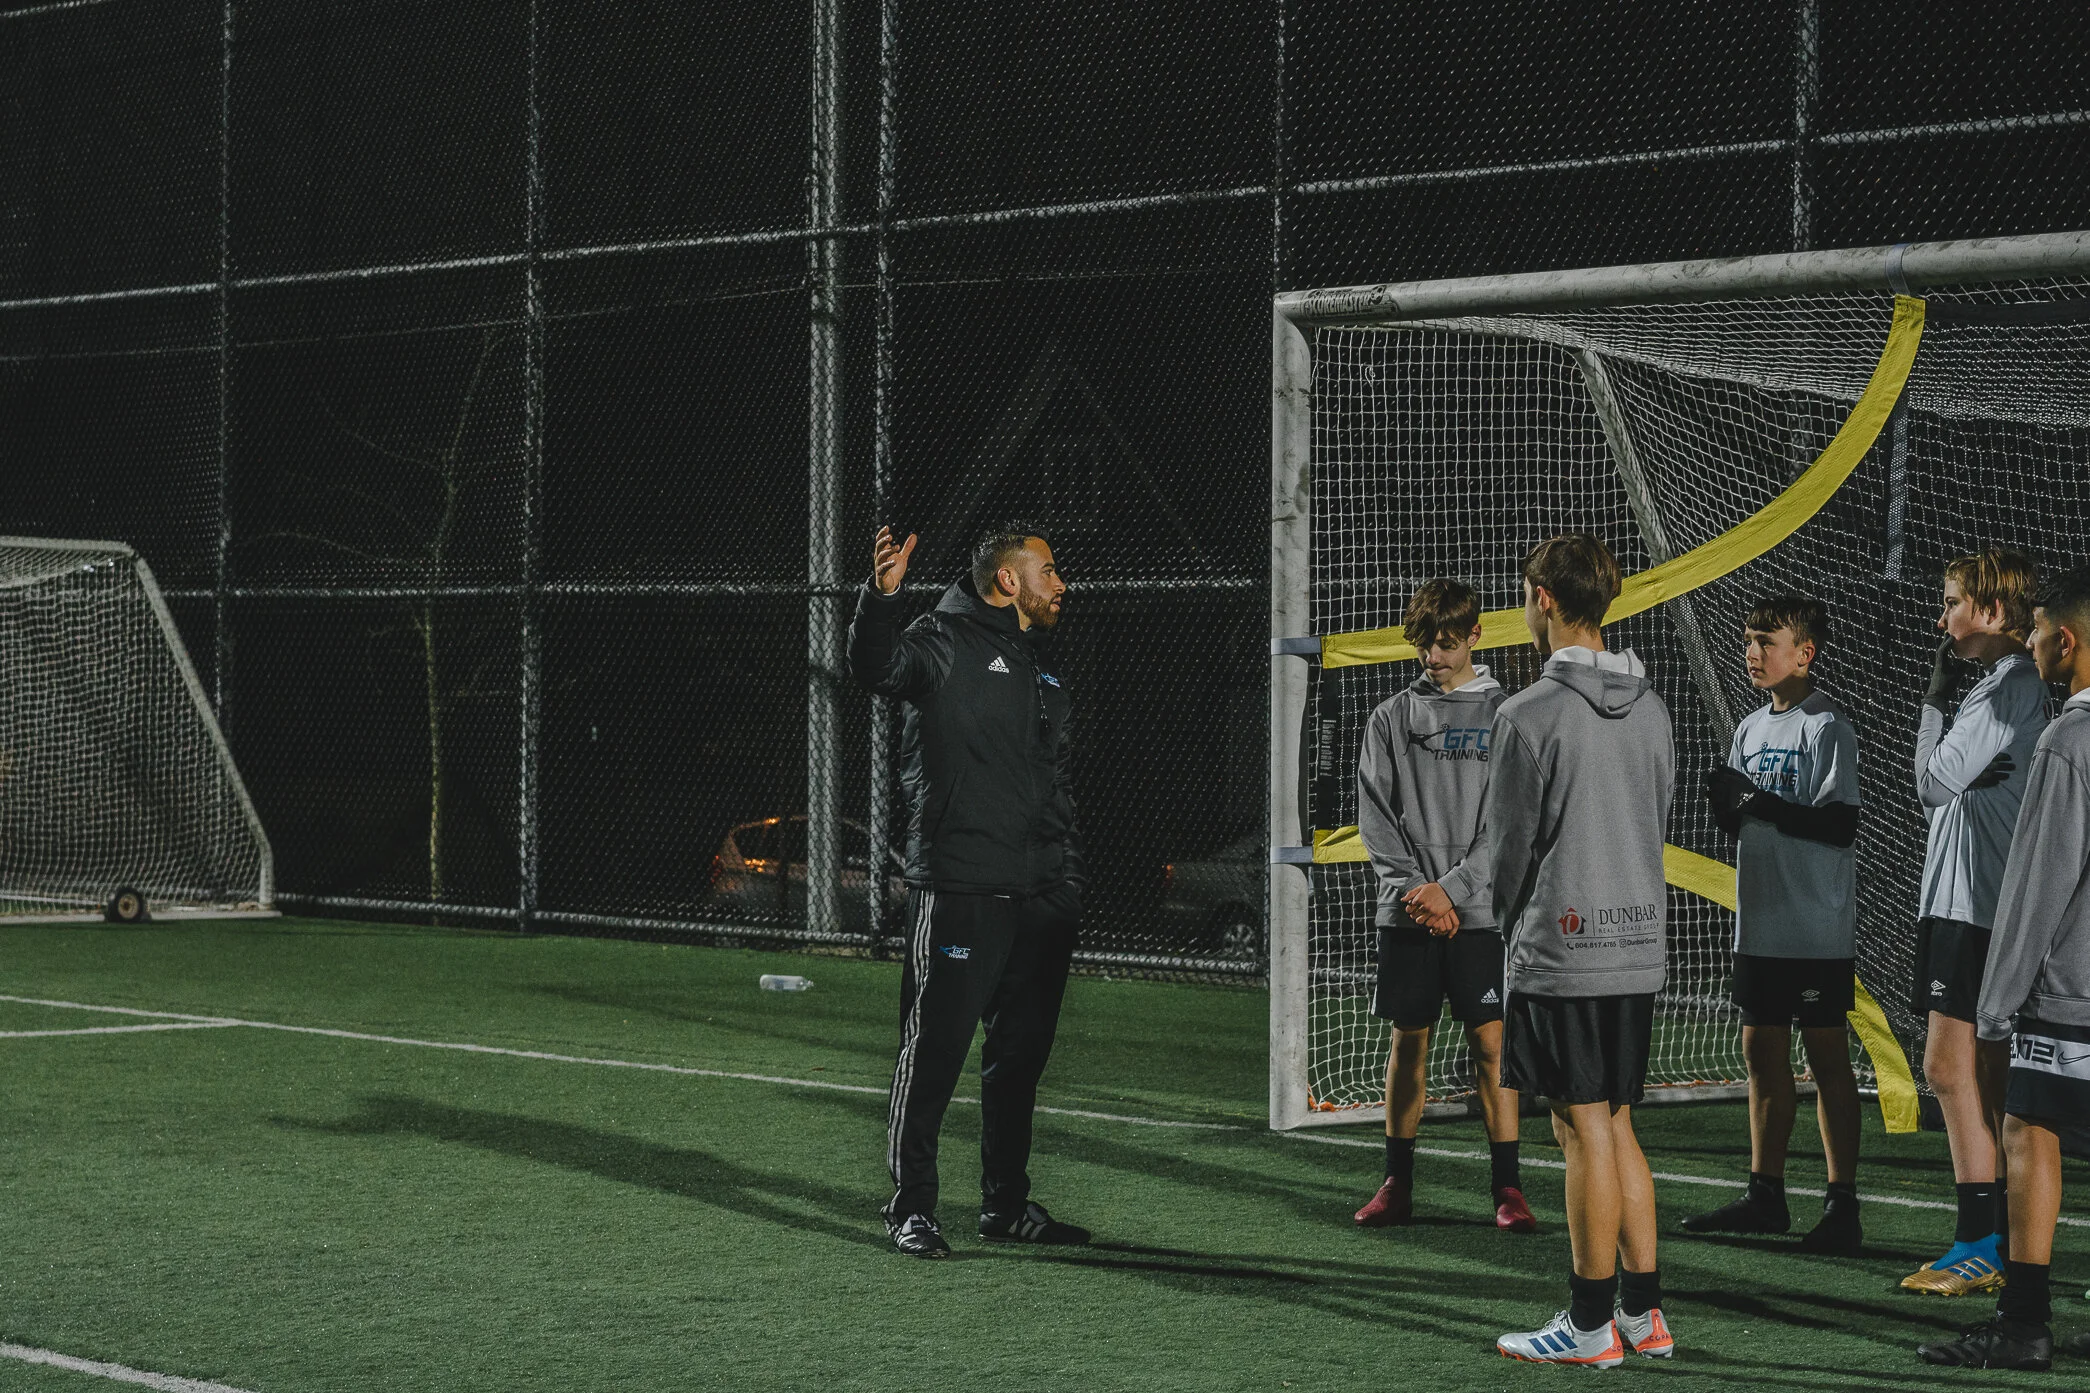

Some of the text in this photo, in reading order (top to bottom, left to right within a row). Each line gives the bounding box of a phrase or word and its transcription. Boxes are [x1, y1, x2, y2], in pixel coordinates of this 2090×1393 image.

[1443, 728, 1491, 750] GFC
[1434, 749, 1489, 762] TRAINING
[1758, 749, 1801, 774] GFC
[1598, 904, 1658, 925] DUNBAR
[1617, 925, 1641, 933] ESTATE
